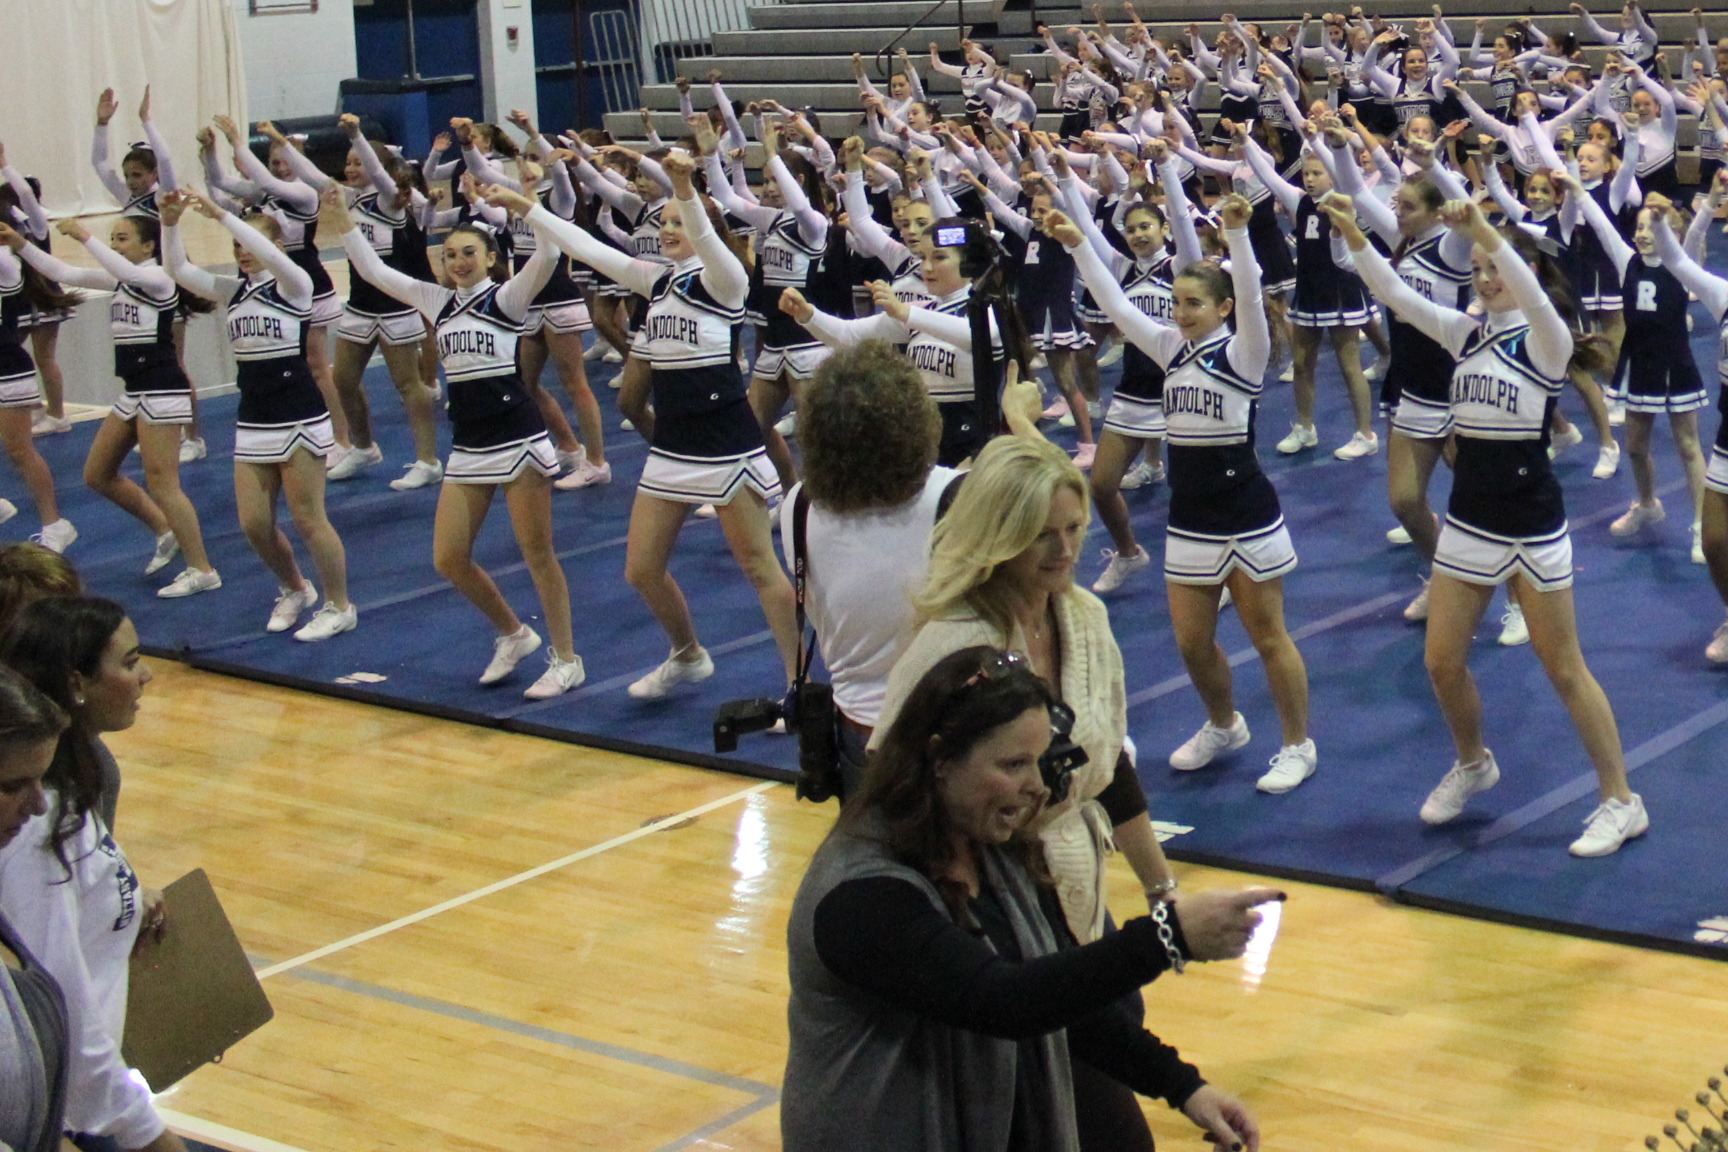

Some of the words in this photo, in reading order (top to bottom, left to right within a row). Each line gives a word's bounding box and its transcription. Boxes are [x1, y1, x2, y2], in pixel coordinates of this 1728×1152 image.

[1304, 215, 1320, 240] R
[1023, 240, 1041, 265] R
[1129, 295, 1173, 319] NDOLPH
[1635, 280, 1658, 312] R
[228, 316, 282, 342] ANDOLPH
[647, 315, 698, 345] ANDOLPH
[438, 330, 495, 359] ANDOLPH
[907, 344, 956, 378] ANDOLPH
[1450, 374, 1519, 414] ANDOLPH
